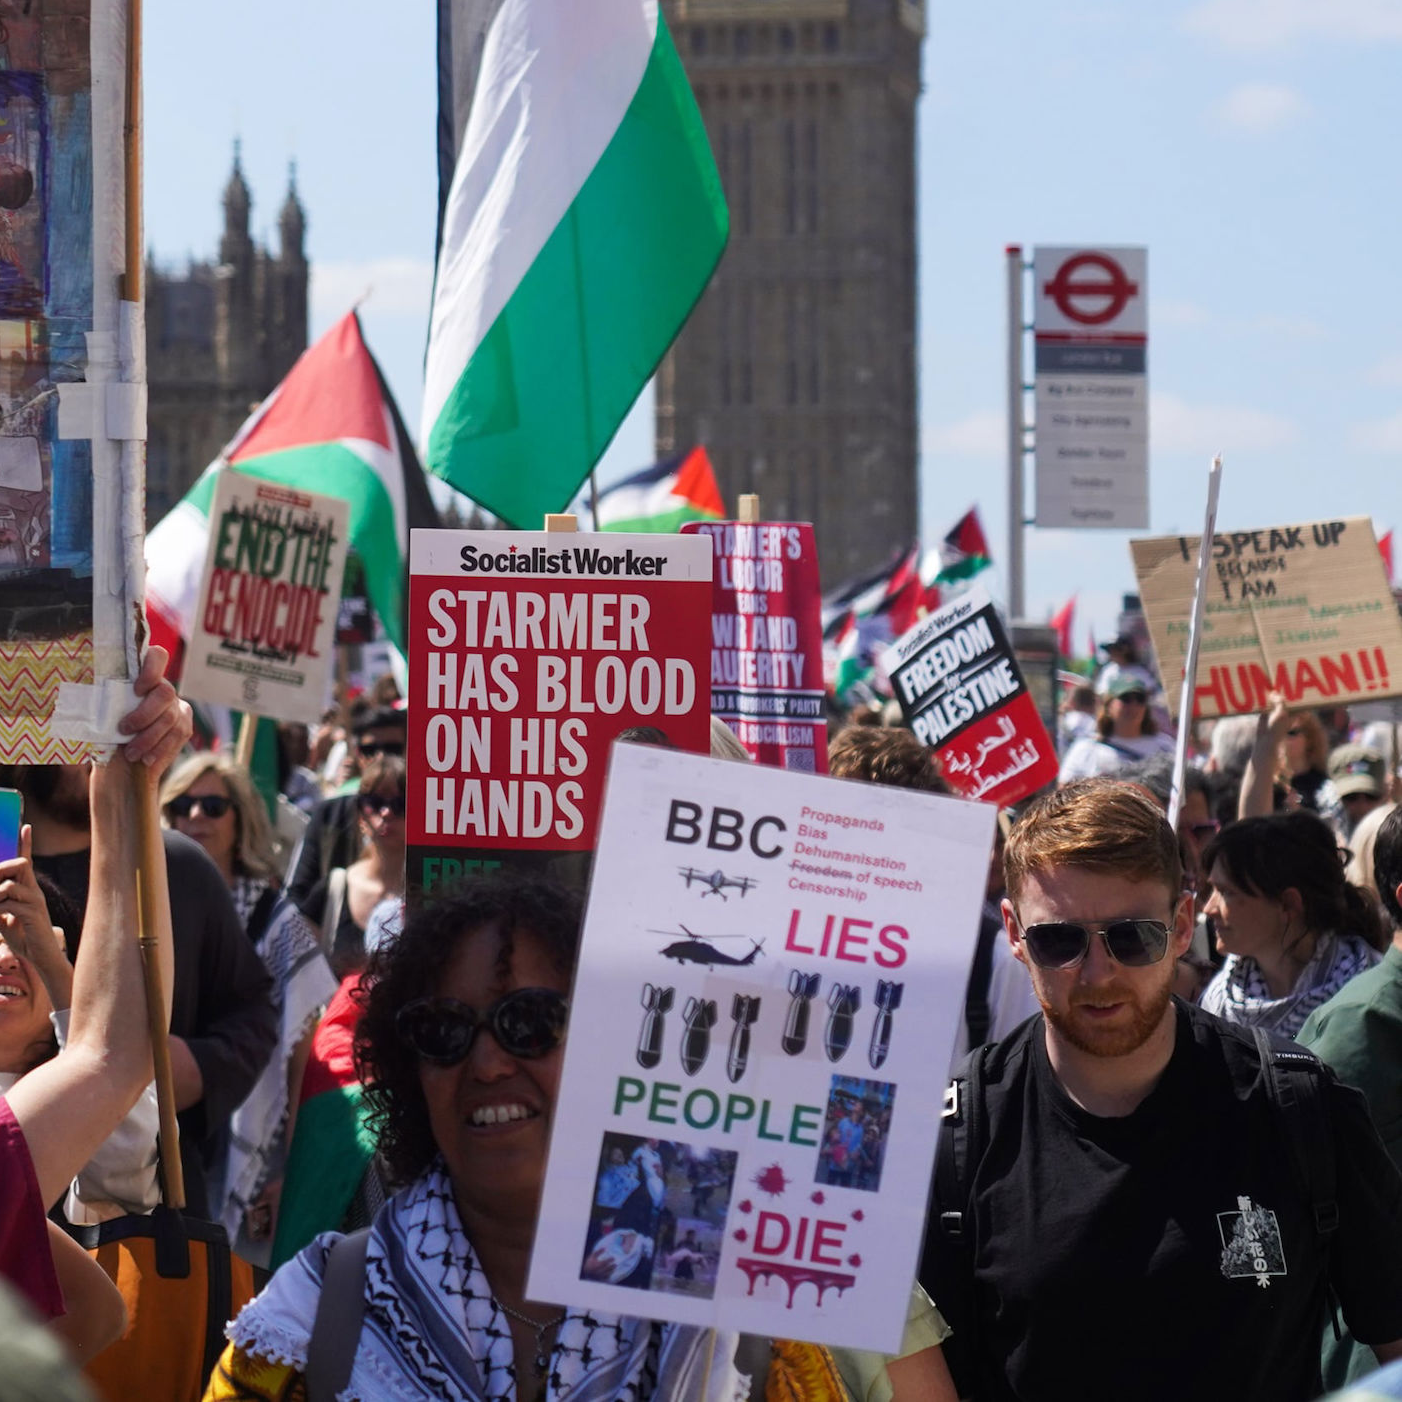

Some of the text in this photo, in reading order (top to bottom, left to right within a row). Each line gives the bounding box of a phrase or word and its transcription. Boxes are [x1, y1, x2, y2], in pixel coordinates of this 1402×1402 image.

[214, 511, 287, 578] END
[291, 531, 338, 594] THE
[459, 544, 669, 576] Socialist Worker
[1212, 526, 1305, 559] SPEAK
[1312, 521, 1347, 548] UP
[1215, 556, 1288, 579] BECAUSE
[203, 566, 325, 659] GENOCIDE
[1241, 579, 1277, 599] AM
[426, 588, 652, 652] STARMER
[753, 615, 798, 652] AND
[426, 651, 697, 716] HAS BLOOD
[899, 615, 996, 706] FREEDOM
[943, 671, 963, 695] for
[912, 657, 1021, 749] PALESTINE
[424, 713, 590, 777] ON HIS
[424, 775, 586, 841] HANDS
[664, 798, 789, 860] BBC
[797, 823, 829, 841] Bias
[799, 805, 886, 832] Propaganda
[788, 858, 924, 894] Freedom of speech
[793, 841, 907, 872] Dehumanisation
[787, 876, 868, 902] Censorship
[784, 908, 911, 970] LIES
[612, 1074, 824, 1148] PEOPLE
[751, 1209, 848, 1268] DIE
